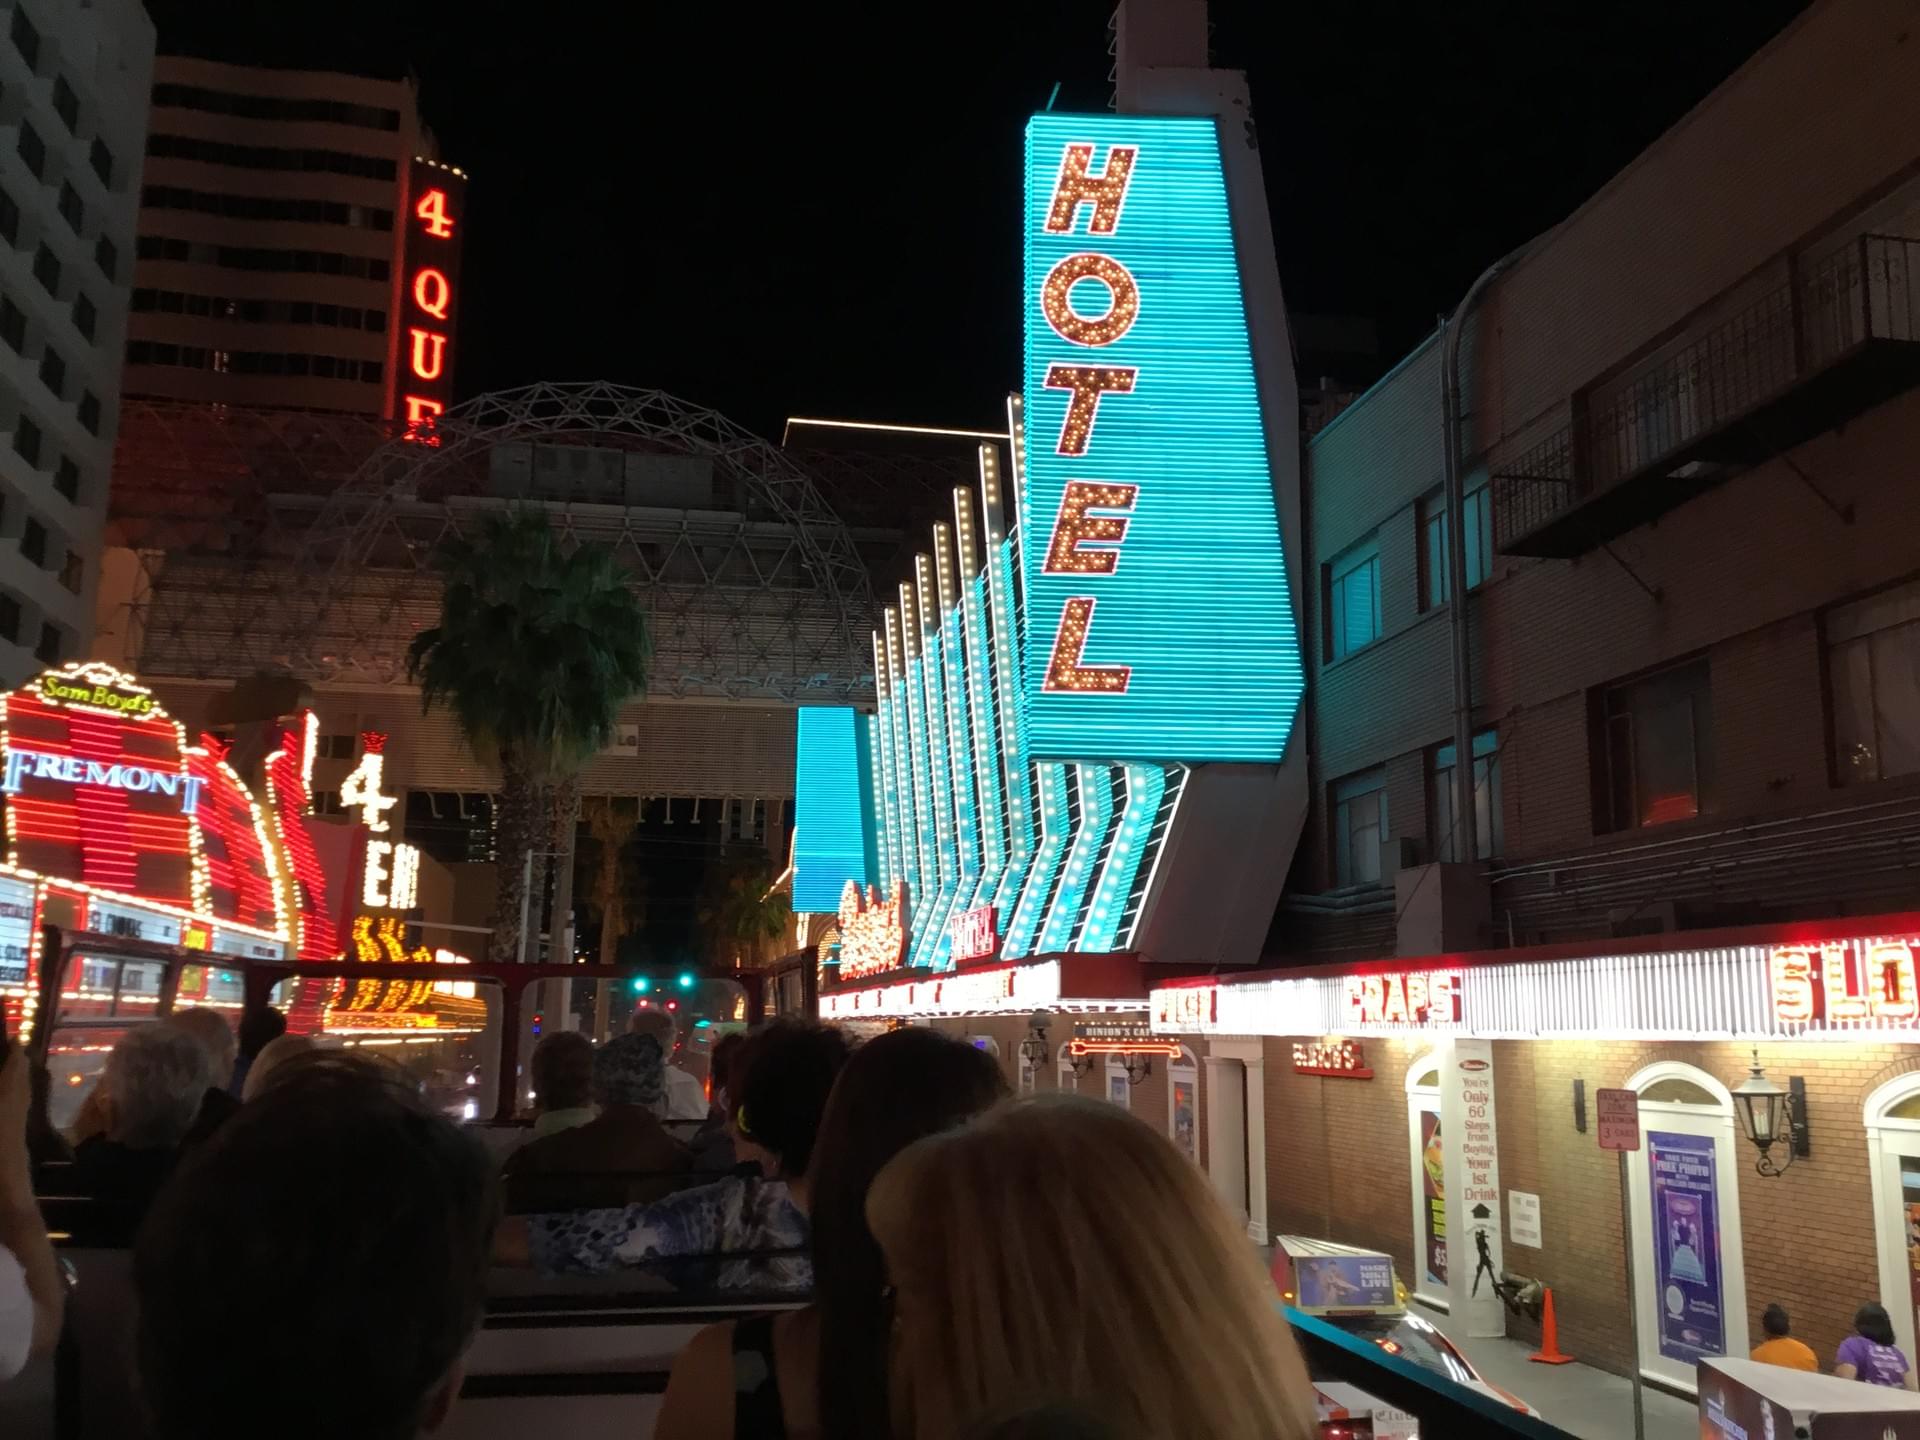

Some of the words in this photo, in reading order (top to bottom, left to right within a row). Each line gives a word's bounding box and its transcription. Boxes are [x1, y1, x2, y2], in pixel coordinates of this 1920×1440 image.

[416, 189, 454, 239] 4
[1041, 142, 1140, 696] HOTEL
[43, 677, 90, 701] Sam
[91, 685, 152, 712] Boyd's
[1, 747, 208, 815] FREMONT
[1345, 973, 1455, 1024] CRAPS
[1086, 1027, 1131, 1037] BINION'S
[1462, 1090, 1489, 1106] Only
[1468, 1105, 1486, 1118] 60
[1464, 1120, 1490, 1133] Steps
[1602, 1127, 1611, 1139] 3
[1467, 1132, 1489, 1142] from
[1462, 1143, 1495, 1156] Buying
[1465, 1156, 1493, 1169] Your
[1678, 1163, 1710, 1177] PHOTO
[1464, 1187, 1498, 1201] Drink
[1360, 1271, 1389, 1279] MIKE
[1361, 1279, 1390, 1288] LIVE
